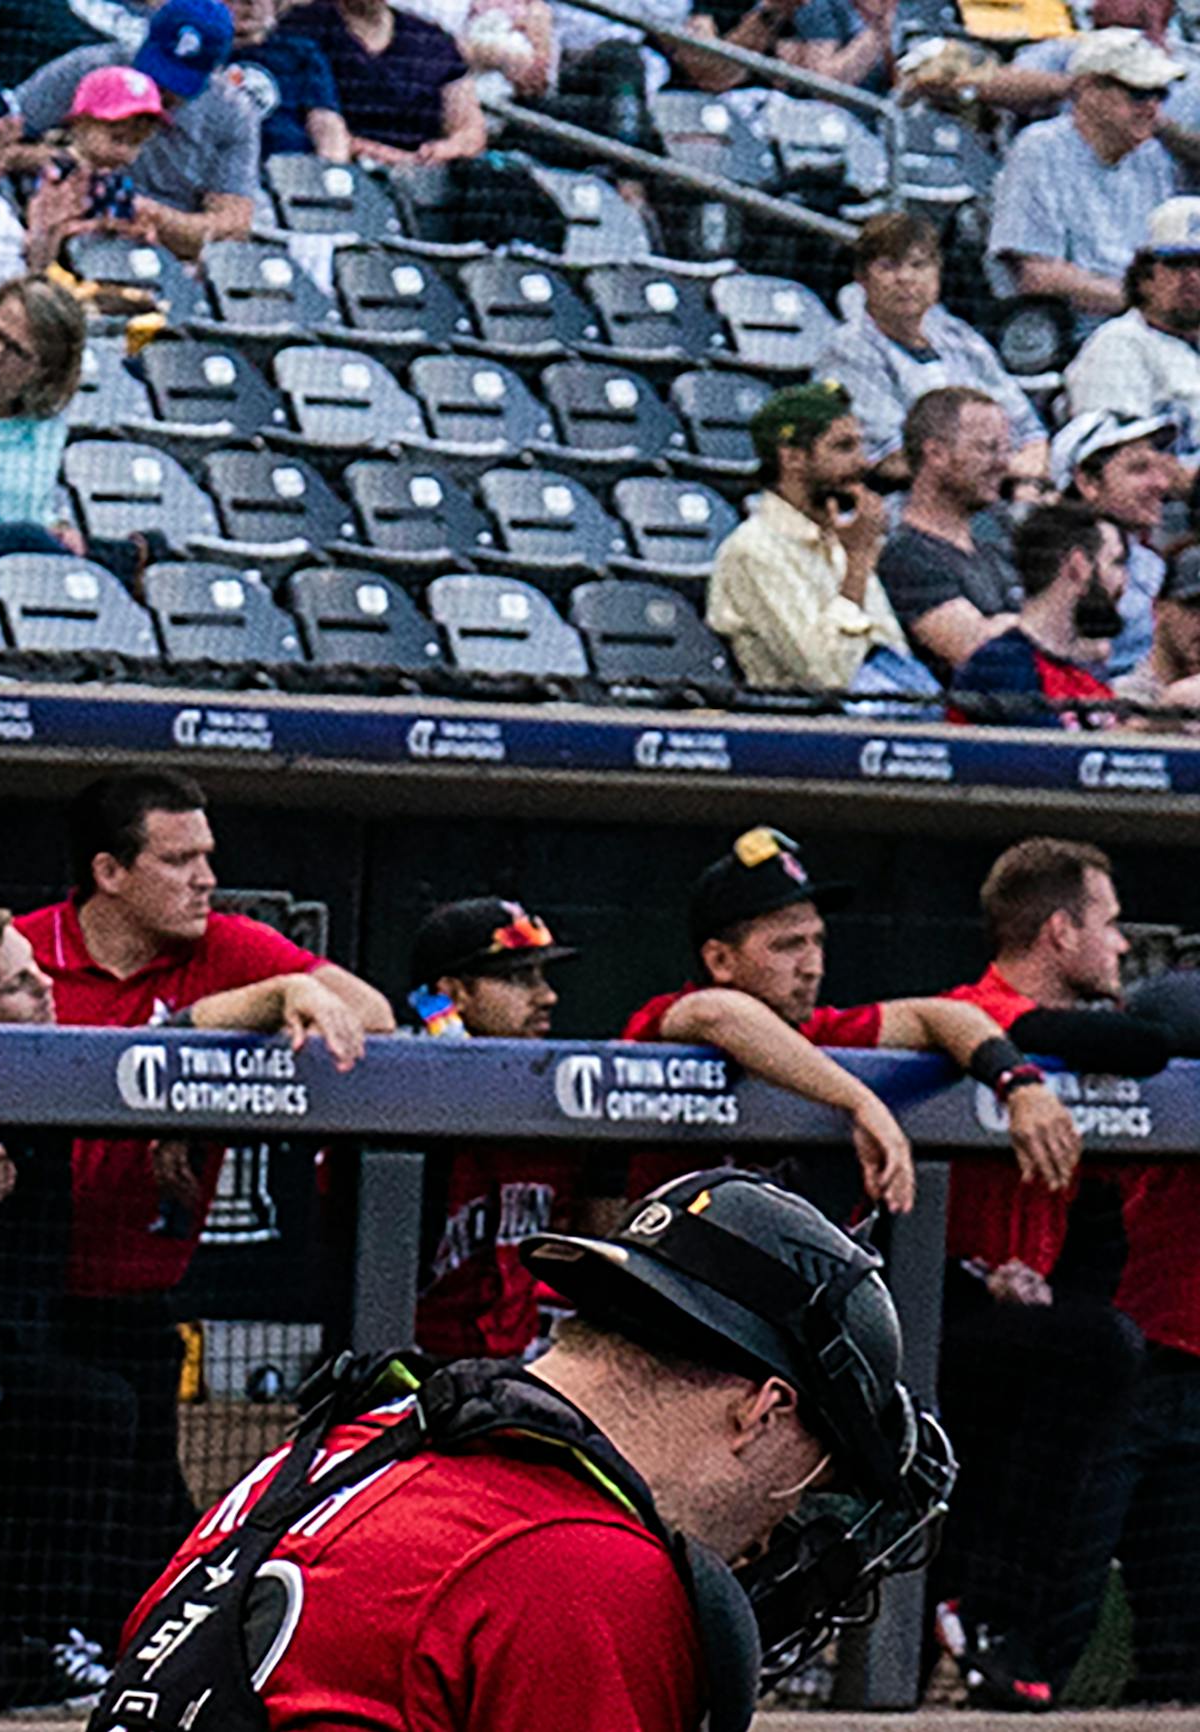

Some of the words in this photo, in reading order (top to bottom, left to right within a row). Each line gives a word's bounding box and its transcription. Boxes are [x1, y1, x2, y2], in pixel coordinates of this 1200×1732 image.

[180, 1046, 232, 1078] TWIN
[234, 1048, 297, 1079] CITIES
[613, 1056, 665, 1088] TWIN
[171, 1080, 308, 1115] ORTHOPEDICS
[606, 1089, 738, 1125] ORTHOPEDICS
